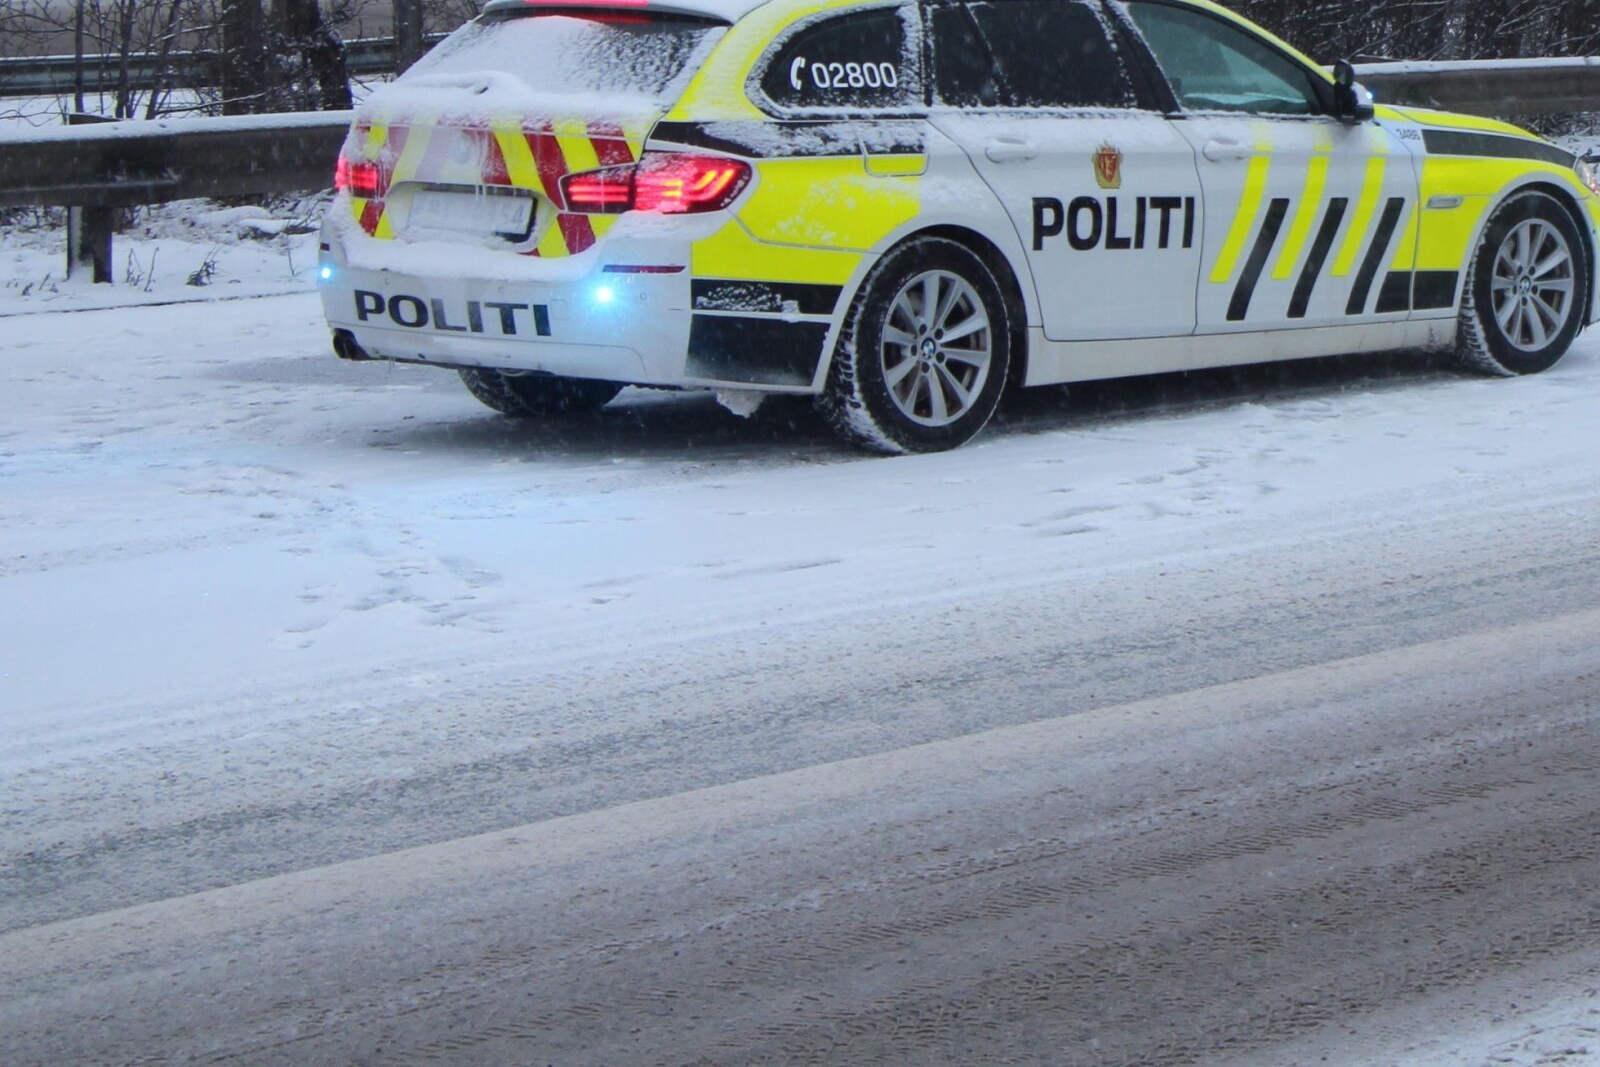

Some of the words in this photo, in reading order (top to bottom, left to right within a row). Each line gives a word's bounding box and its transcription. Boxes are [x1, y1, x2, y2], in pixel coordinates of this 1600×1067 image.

[811, 62, 898, 88] 02800
[1032, 196, 1195, 251] POLITI
[354, 289, 552, 336] POLITI
